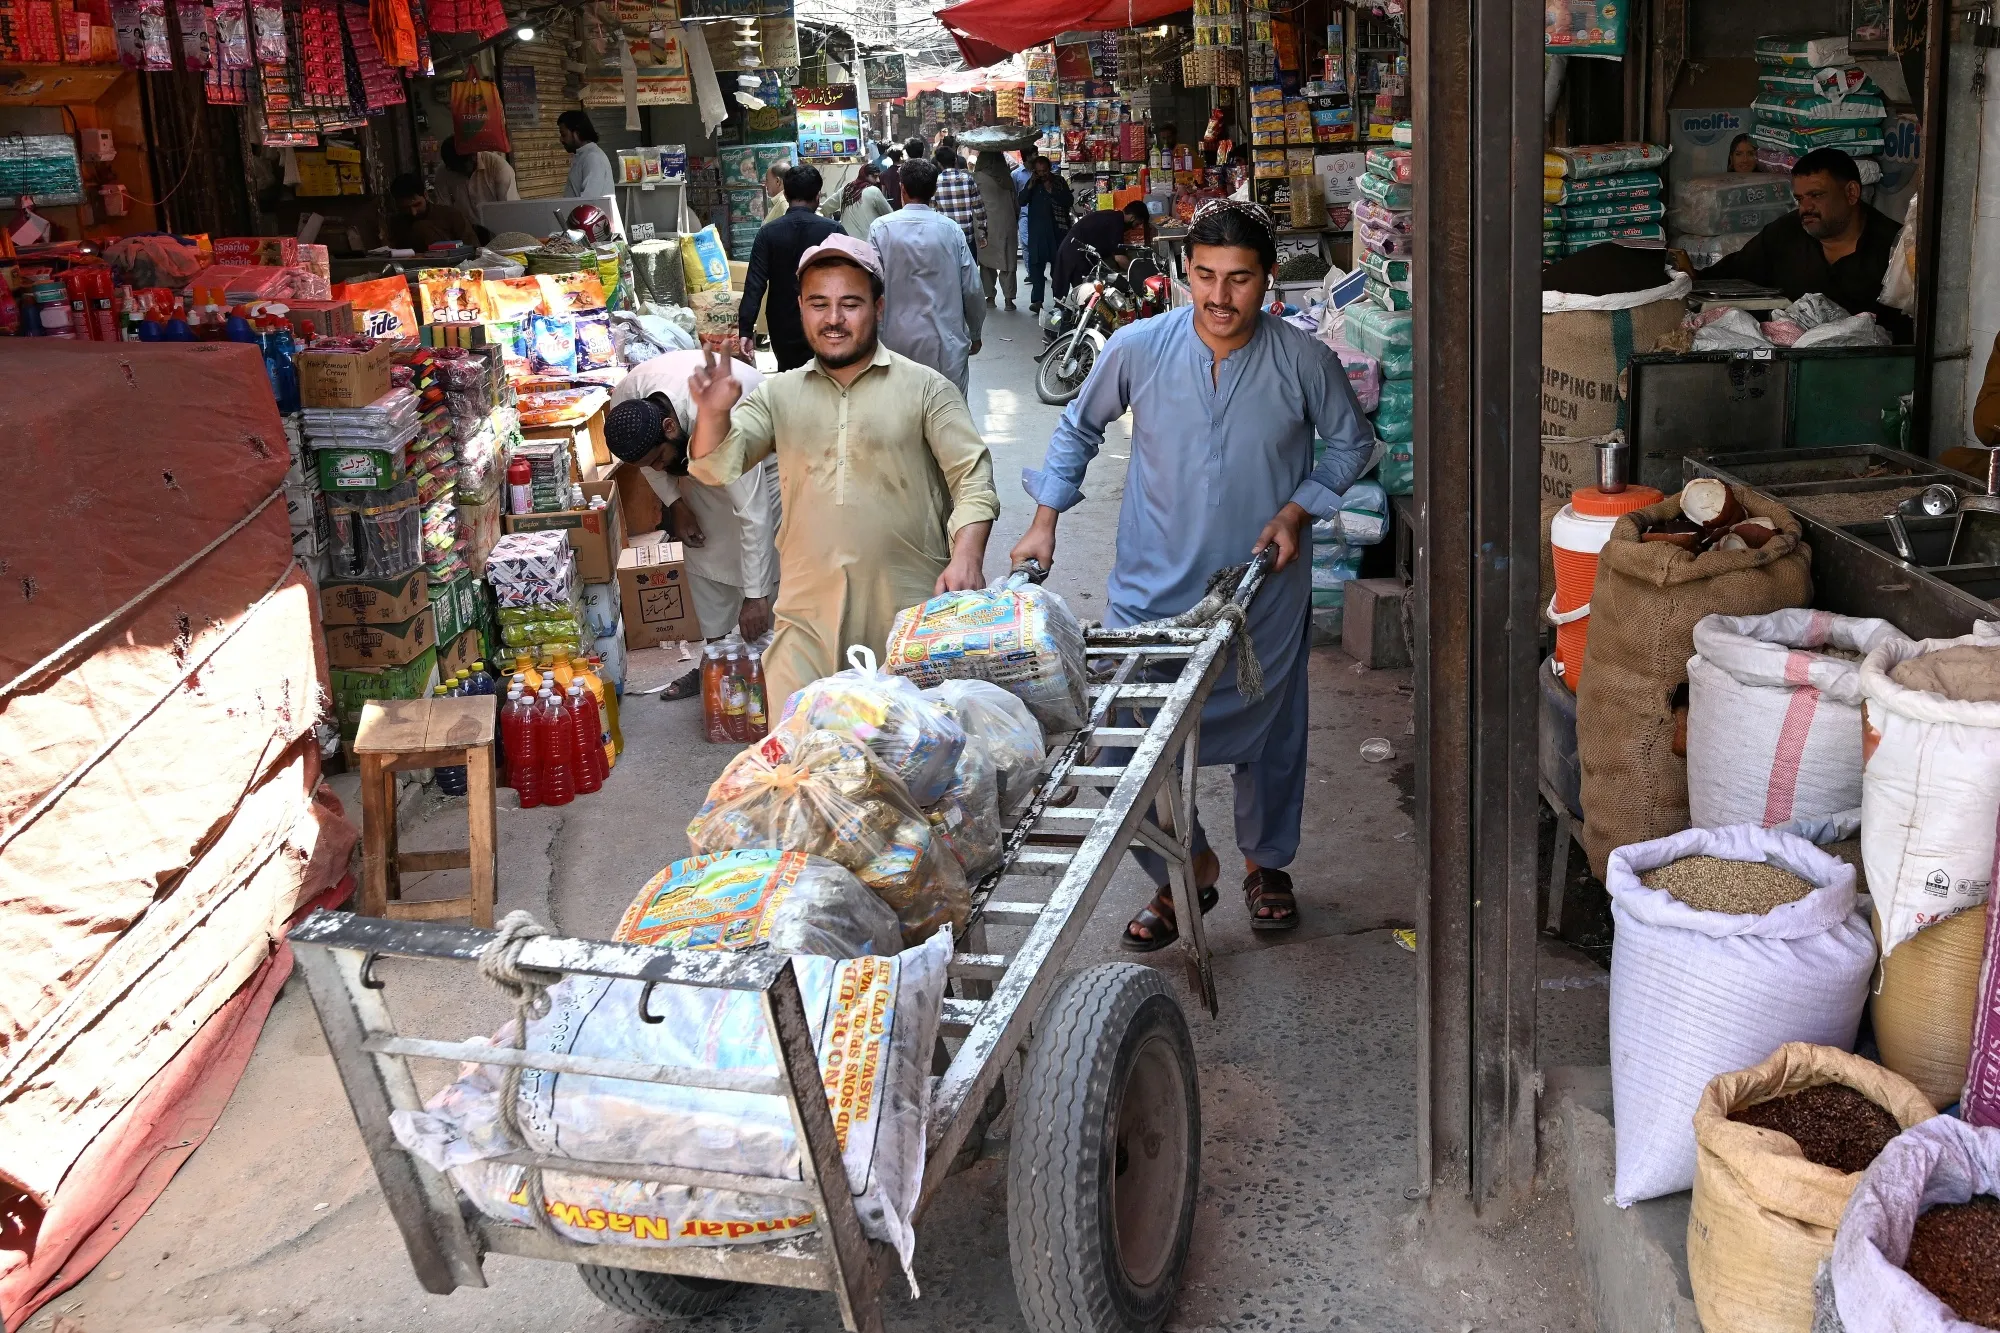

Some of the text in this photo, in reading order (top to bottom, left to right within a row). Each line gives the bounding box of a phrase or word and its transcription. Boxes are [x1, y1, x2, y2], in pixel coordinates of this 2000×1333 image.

[824, 91, 844, 105] صوفی
[1683, 112, 1740, 131] molfix
[1884, 122, 1921, 159] olfi
[217, 242, 250, 253] Sparkle
[219, 256, 251, 266] Sparkle
[432, 306, 478, 322] Sher
[370, 311, 398, 337] ide
[321, 361, 351, 369] Removal
[325, 369, 347, 377] Cream
[1542, 365, 1597, 400] IPPING
[1543, 393, 1578, 421] RDEN
[1541, 420, 1566, 437] ADE
[1549, 450, 1572, 475] NO.
[1542, 474, 1573, 499] OICE
[336, 590, 377, 608] Supreme
[343, 632, 383, 648] Supreme
[342, 674, 391, 691] Lara
[840, 1062, 859, 1107] SONS
[859, 956, 875, 993] MARD
[856, 1039, 880, 1121] NASWAR
[869, 988, 889, 1035] (PVT)
[509, 1179, 816, 1241] andar Naswr
